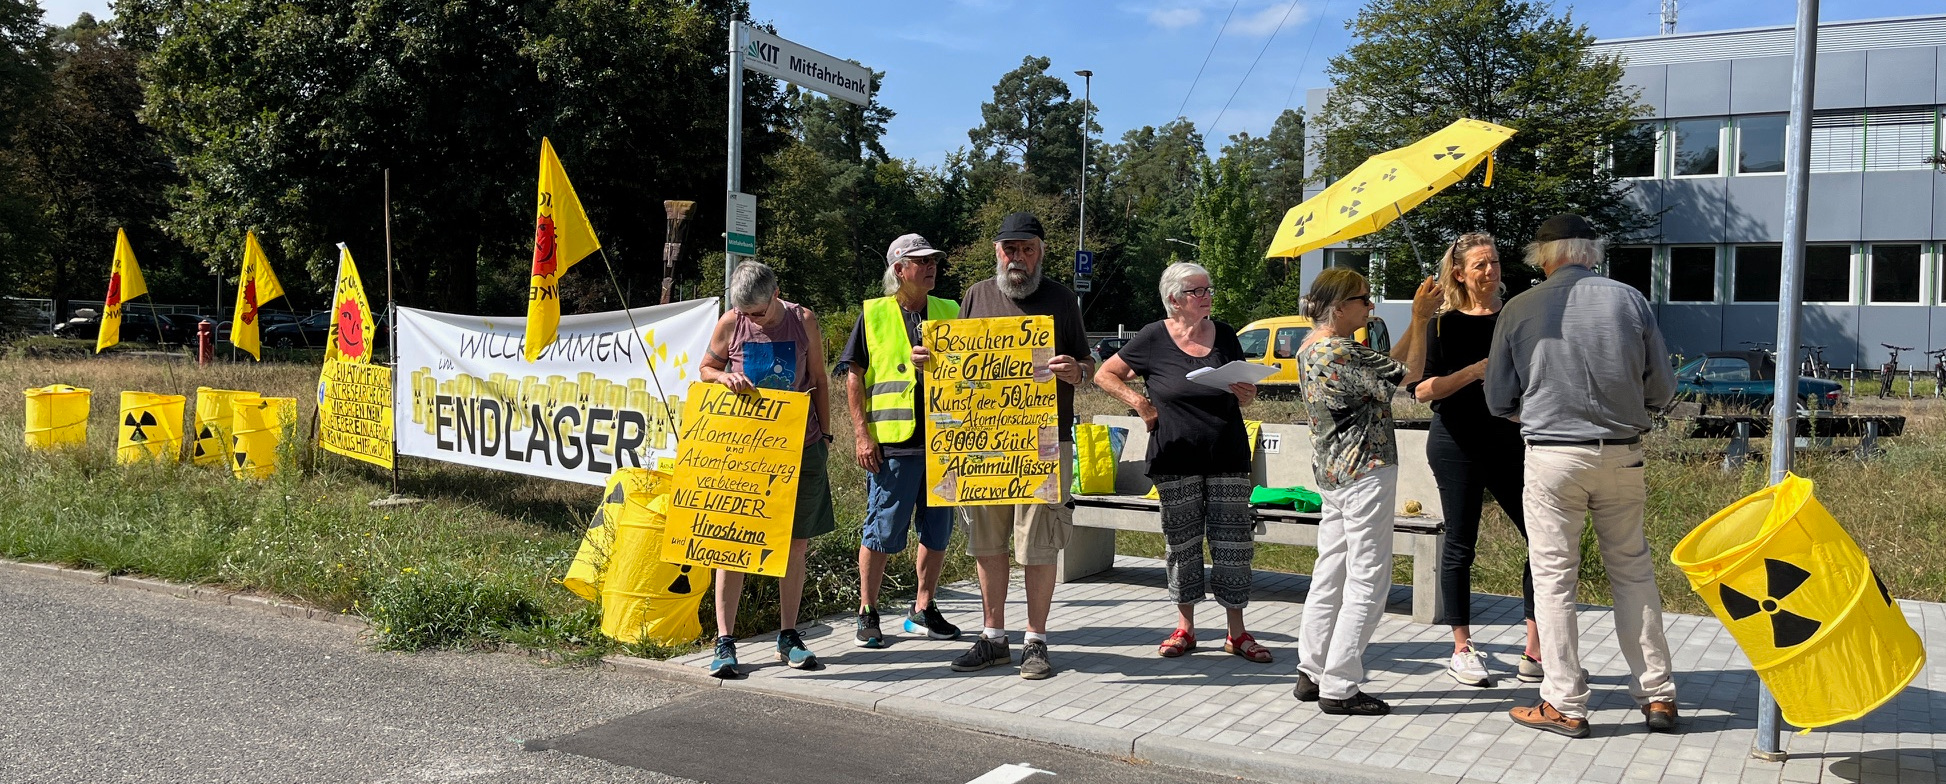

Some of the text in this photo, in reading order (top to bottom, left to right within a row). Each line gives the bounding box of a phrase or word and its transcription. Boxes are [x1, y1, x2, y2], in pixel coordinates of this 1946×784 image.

[757, 41, 779, 64] KIT
[789, 55, 866, 94] Mitfahrbank
[1079, 254, 1088, 270] P
[934, 319, 1050, 353] Besuchen Sie
[932, 352, 1033, 380] die 6 Hallen
[699, 389, 790, 420] WELTWEIT
[929, 383, 1056, 412] Kunst der 50 Jahre
[960, 408, 1048, 430] Atomforschung
[435, 395, 646, 474] ENDLAGER
[683, 415, 788, 453] Atomwaffen
[990, 429, 1037, 451] Stück
[1258, 438, 1279, 450] KIT
[726, 445, 744, 454] und
[679, 447, 797, 484] Atomforschung
[942, 454, 1058, 479] Atommüllfässer
[960, 477, 1032, 499] hier vor Ort
[673, 488, 769, 518] NIE WIEDER
[671, 537, 686, 546] und
[690, 512, 767, 544] Hiroshima
